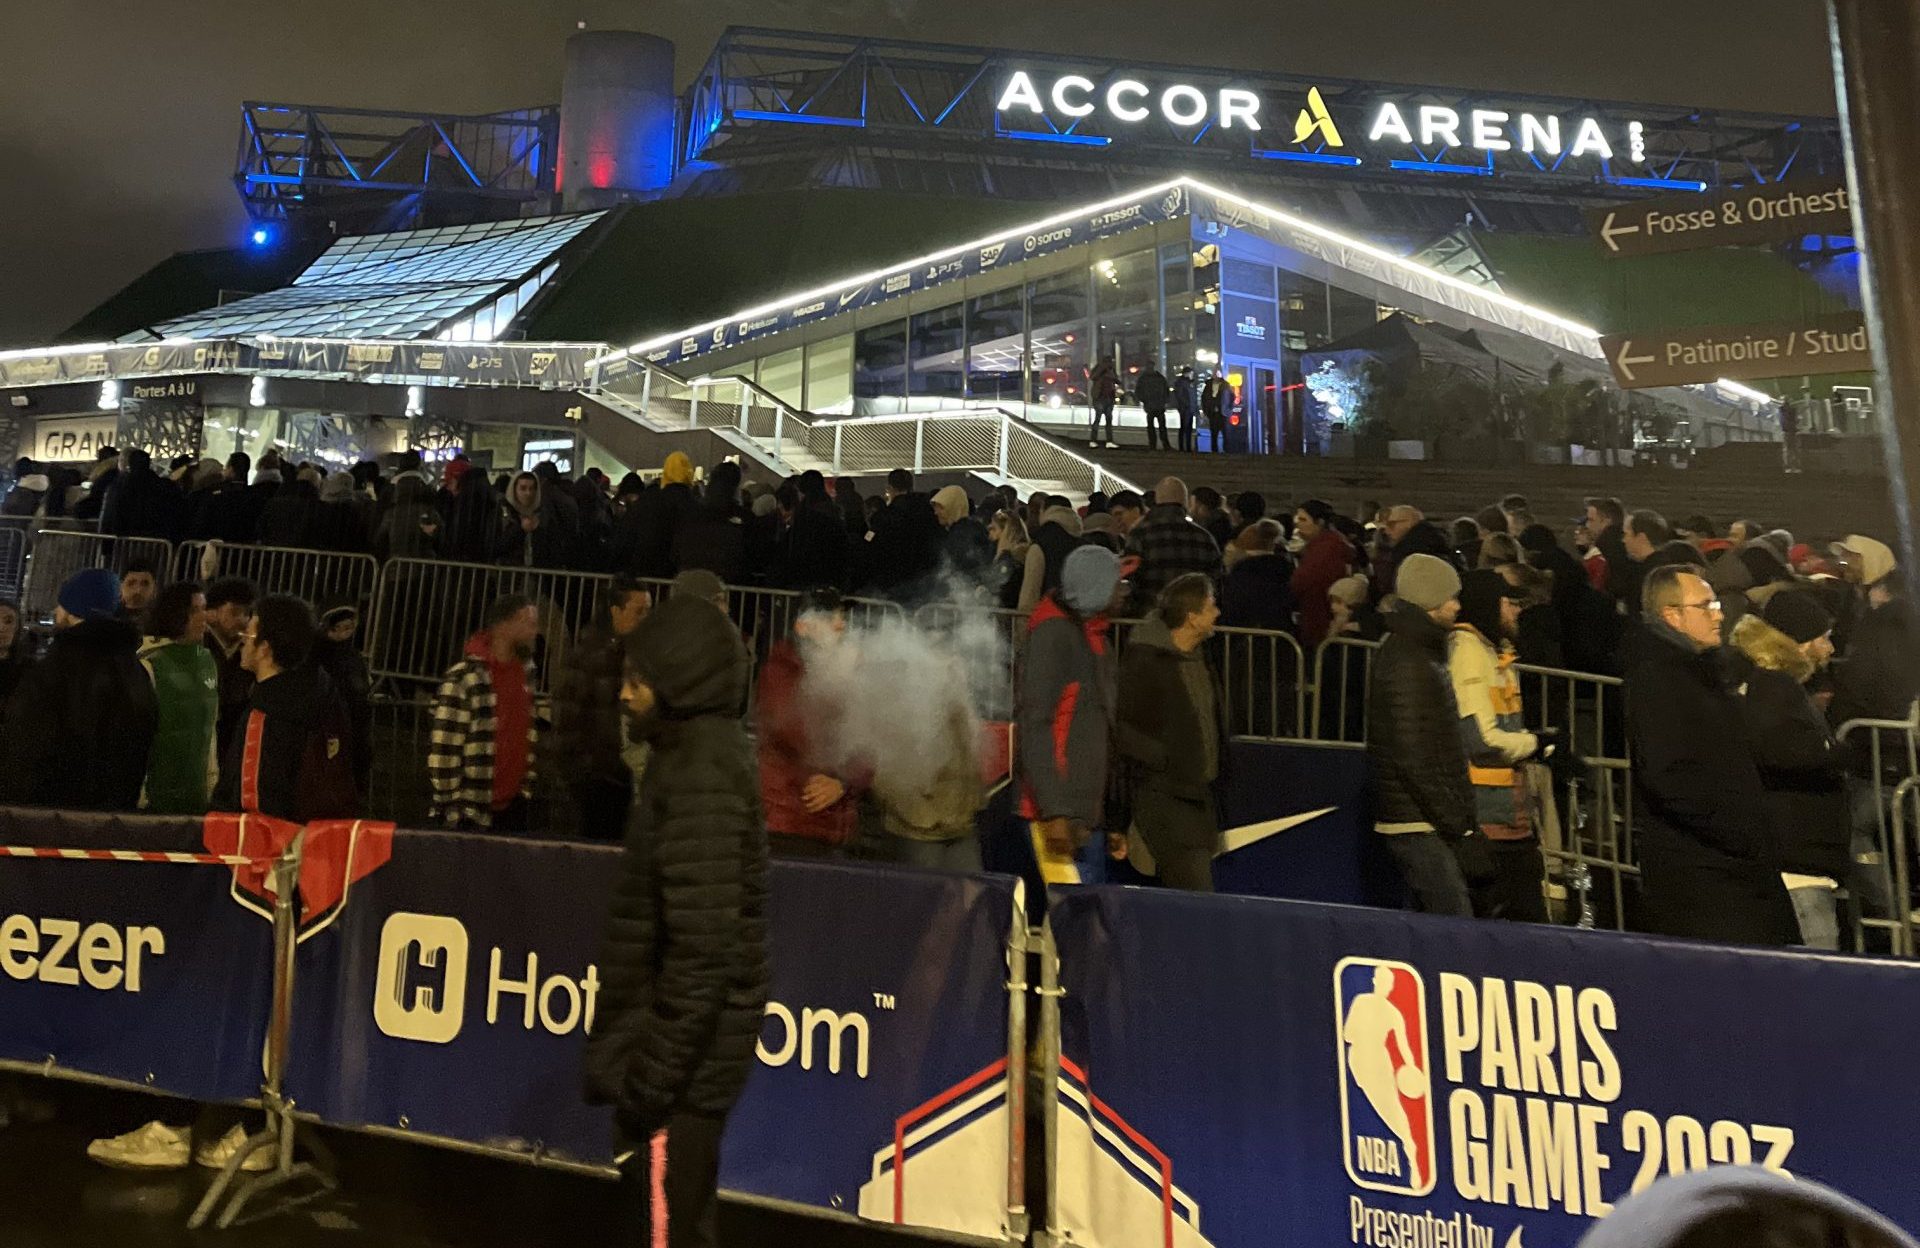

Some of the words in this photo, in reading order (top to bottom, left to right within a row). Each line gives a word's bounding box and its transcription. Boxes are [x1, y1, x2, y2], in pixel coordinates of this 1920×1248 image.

[997, 71, 1262, 131] ACCOR
[1369, 102, 1612, 159] ARENA
[1103, 204, 1141, 223] TISSOT
[1647, 211, 1716, 235] Fosse
[1723, 201, 1741, 225] &
[1748, 188, 1850, 221] Orchest
[1038, 227, 1072, 246] sorare
[939, 261, 963, 275] PS5
[480, 357, 503, 369] PS5
[1667, 336, 1778, 366] Patinoire
[1803, 327, 1866, 355] Stud
[133, 385, 166, 398] Portes
[168, 383, 176, 396] A
[187, 382, 195, 395] U
[45, 431, 113, 459] GRAN
[0, 914, 165, 992] ezer
[1439, 972, 1622, 1102] PARIS
[1356, 1135, 1401, 1177] NBA
[1449, 1088, 1615, 1219] GAME
[1350, 1195, 1462, 1248] Presented
